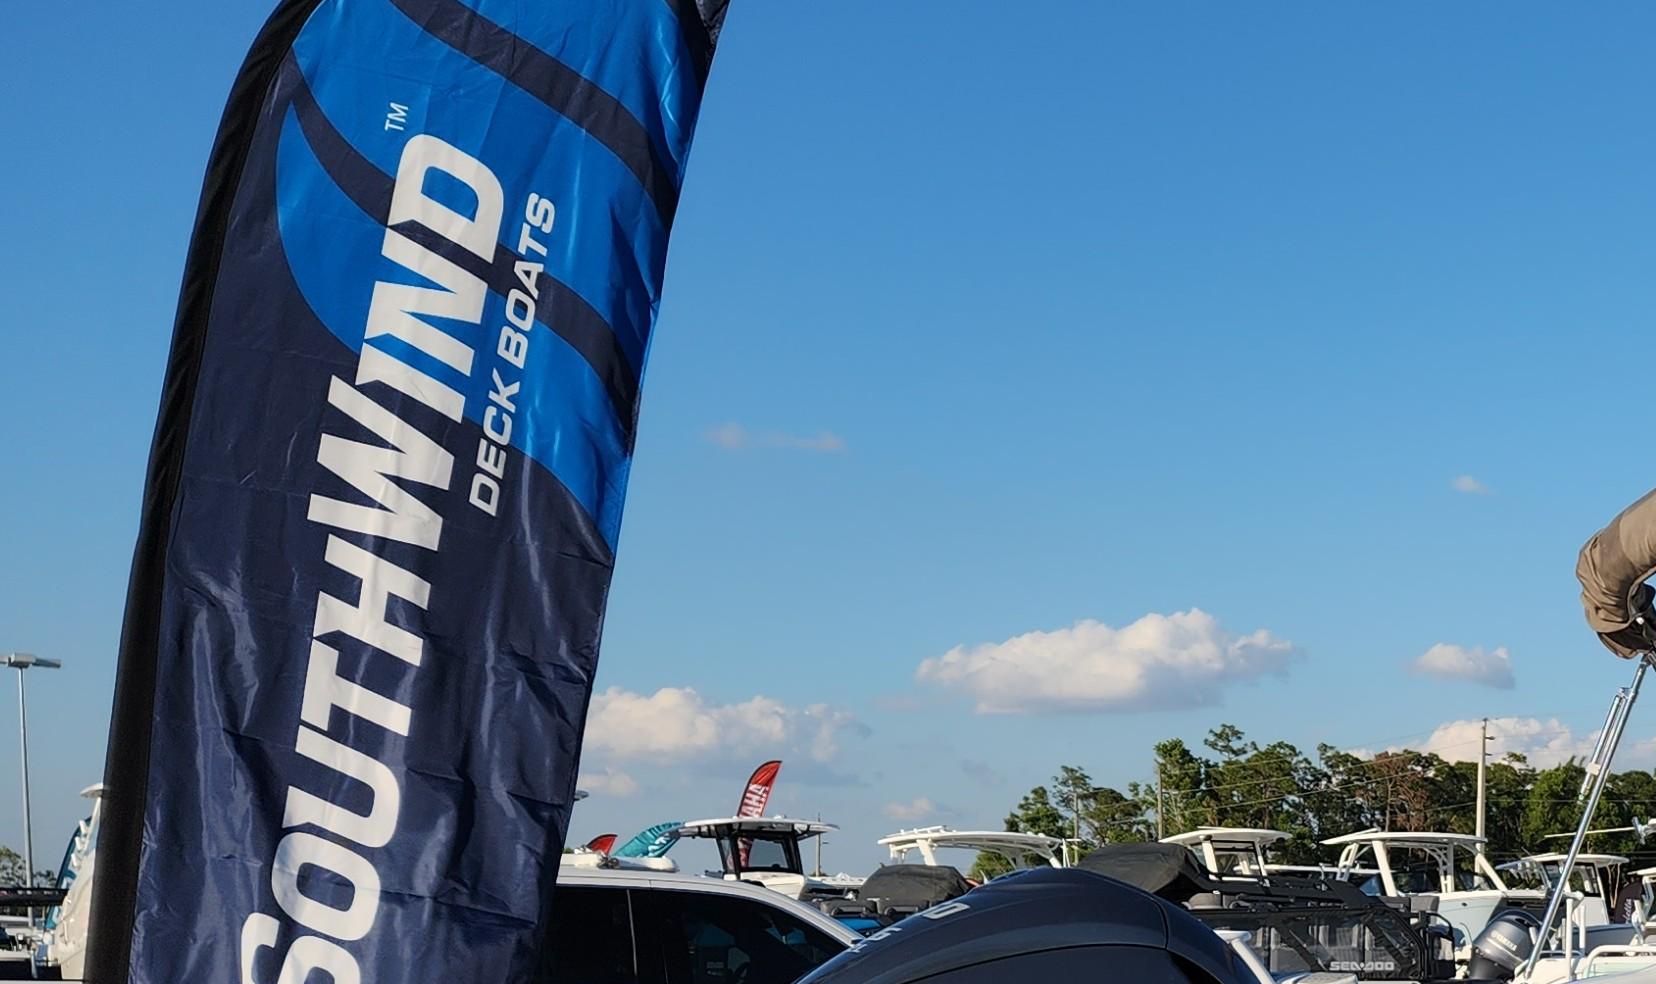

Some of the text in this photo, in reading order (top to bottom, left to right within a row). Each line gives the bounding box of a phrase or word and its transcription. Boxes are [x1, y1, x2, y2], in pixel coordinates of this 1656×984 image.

[384, 102, 409, 131] TM
[469, 193, 555, 516] DECK BOATS
